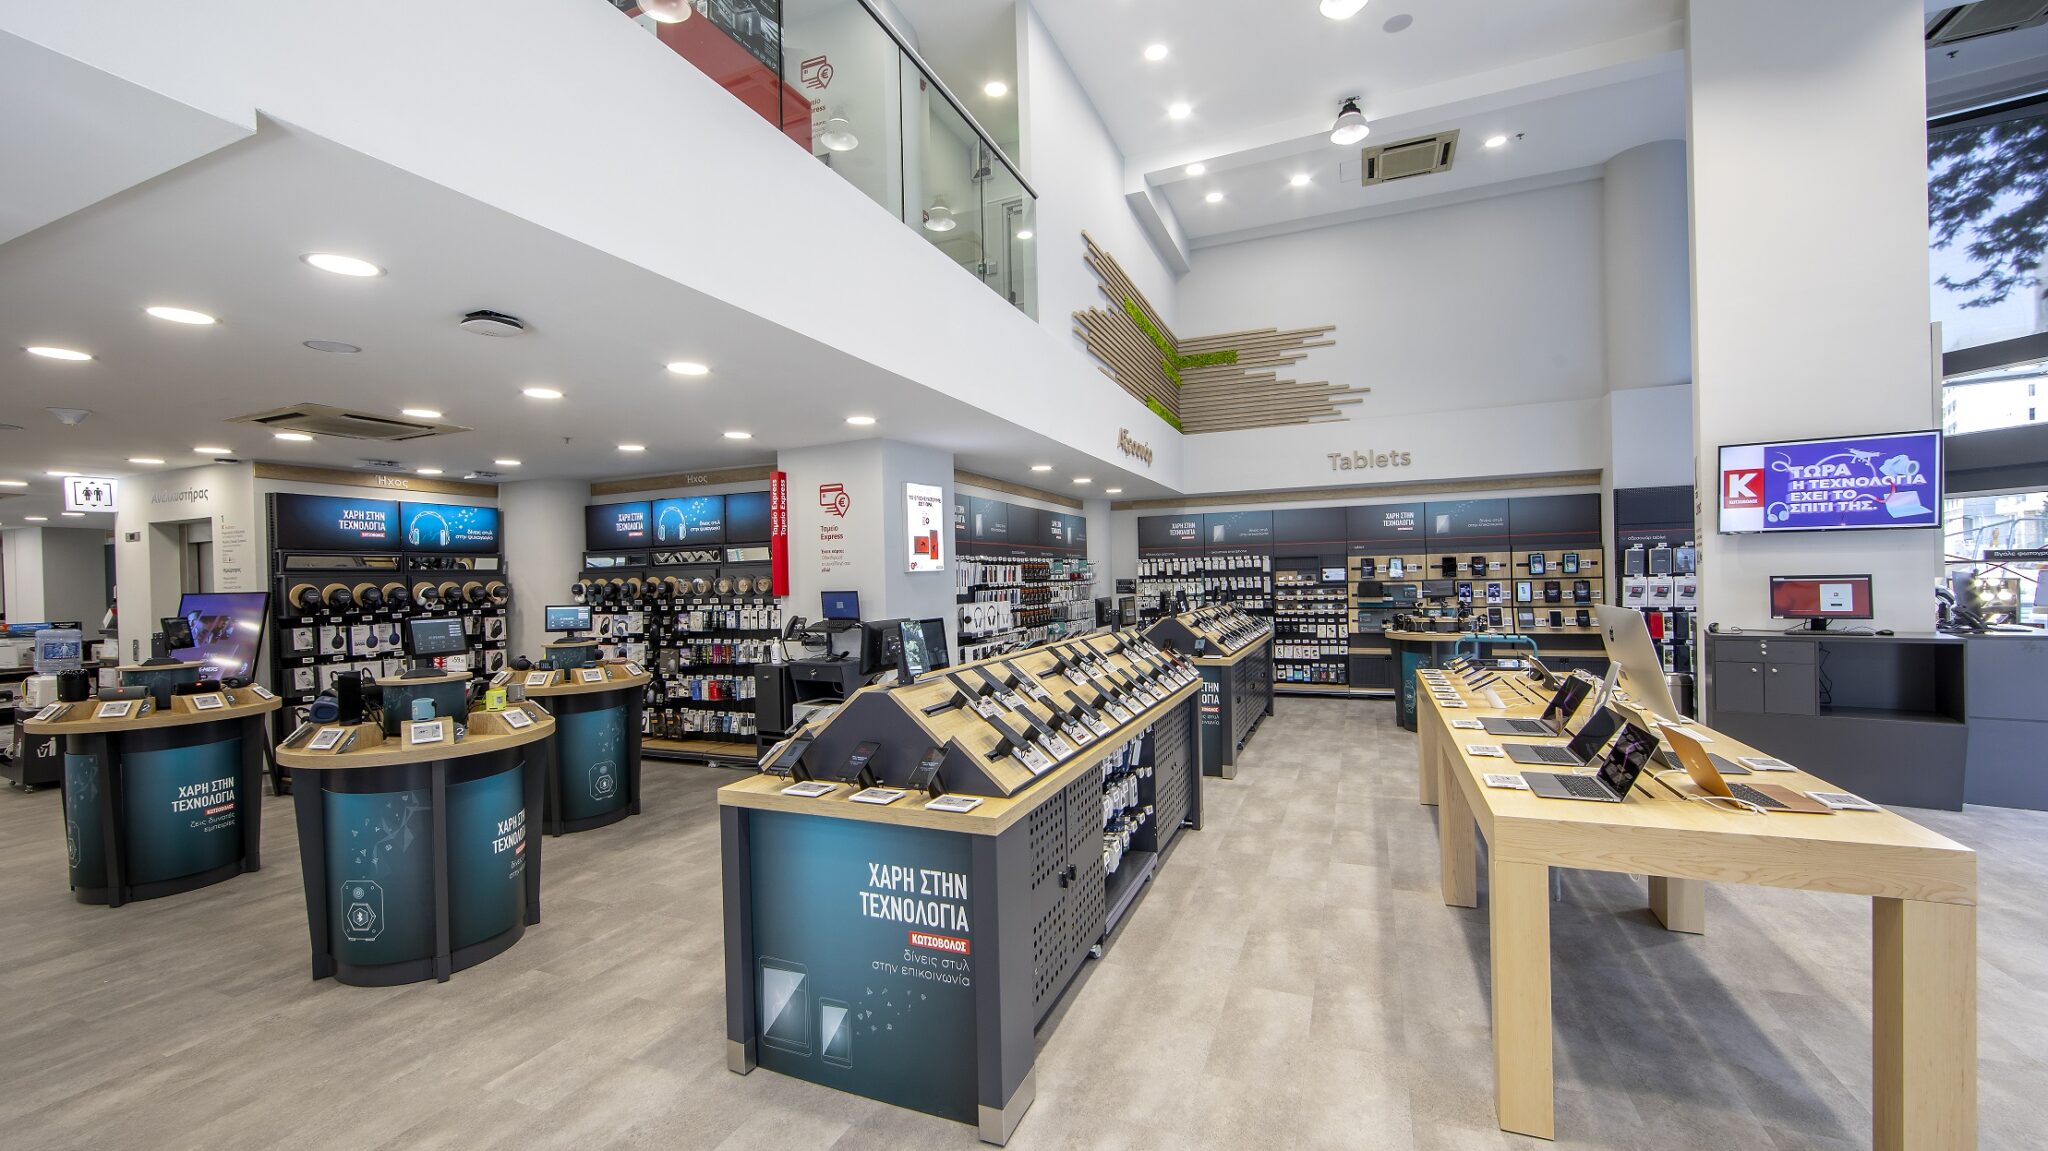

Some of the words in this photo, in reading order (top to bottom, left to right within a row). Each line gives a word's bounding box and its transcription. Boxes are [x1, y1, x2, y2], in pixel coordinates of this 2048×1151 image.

[1327, 449, 1412, 471] Tablets
[1792, 463, 1852, 480] ΤΩΡΑ
[1792, 480, 1805, 490] Η
[1809, 474, 1927, 489] ΤΕΧΝΟΛΟΓΙΑ
[151, 487, 209, 504] Ανελκυστήρας
[1790, 492, 1828, 502] ΕΧΕΙ
[1835, 490, 1858, 500] ΤΟ
[343, 510, 364, 519] ΧΑΡΗ
[366, 511, 385, 521] ΣΤΗΝ
[1789, 503, 1834, 513] ΣΠΙΤΙ
[1836, 501, 1878, 511] ΤΗΣ.
[339, 520, 386, 531] ΤΕΧΝΟΛΟΓΙΑ
[820, 525, 839, 533] Ταμείο
[1201, 682, 1219, 692] ΤΗΝ
[456, 728, 464, 736] 2
[179, 782, 209, 798] ΧΑΡΗ
[211, 776, 235, 792] ΣΤΗΝ
[171, 789, 235, 812] ΤΕΧΝΟΛΟΓΙΑ
[497, 815, 517, 836] ΧΑΡΗ
[868, 862, 915, 893] ΧΑΡΗ
[920, 869, 968, 900] ΣΤΗΝ
[859, 891, 970, 932] ΤΕΧΝΟΛΟΓΙΑ
[911, 933, 967, 953] ΚΩΤΣΟΒΟΛΟΣ
[903, 948, 937, 969] δίνεις
[942, 958, 970, 972] στυλ
[872, 960, 898, 975] στην
[901, 964, 971, 987] επικοινωνία
